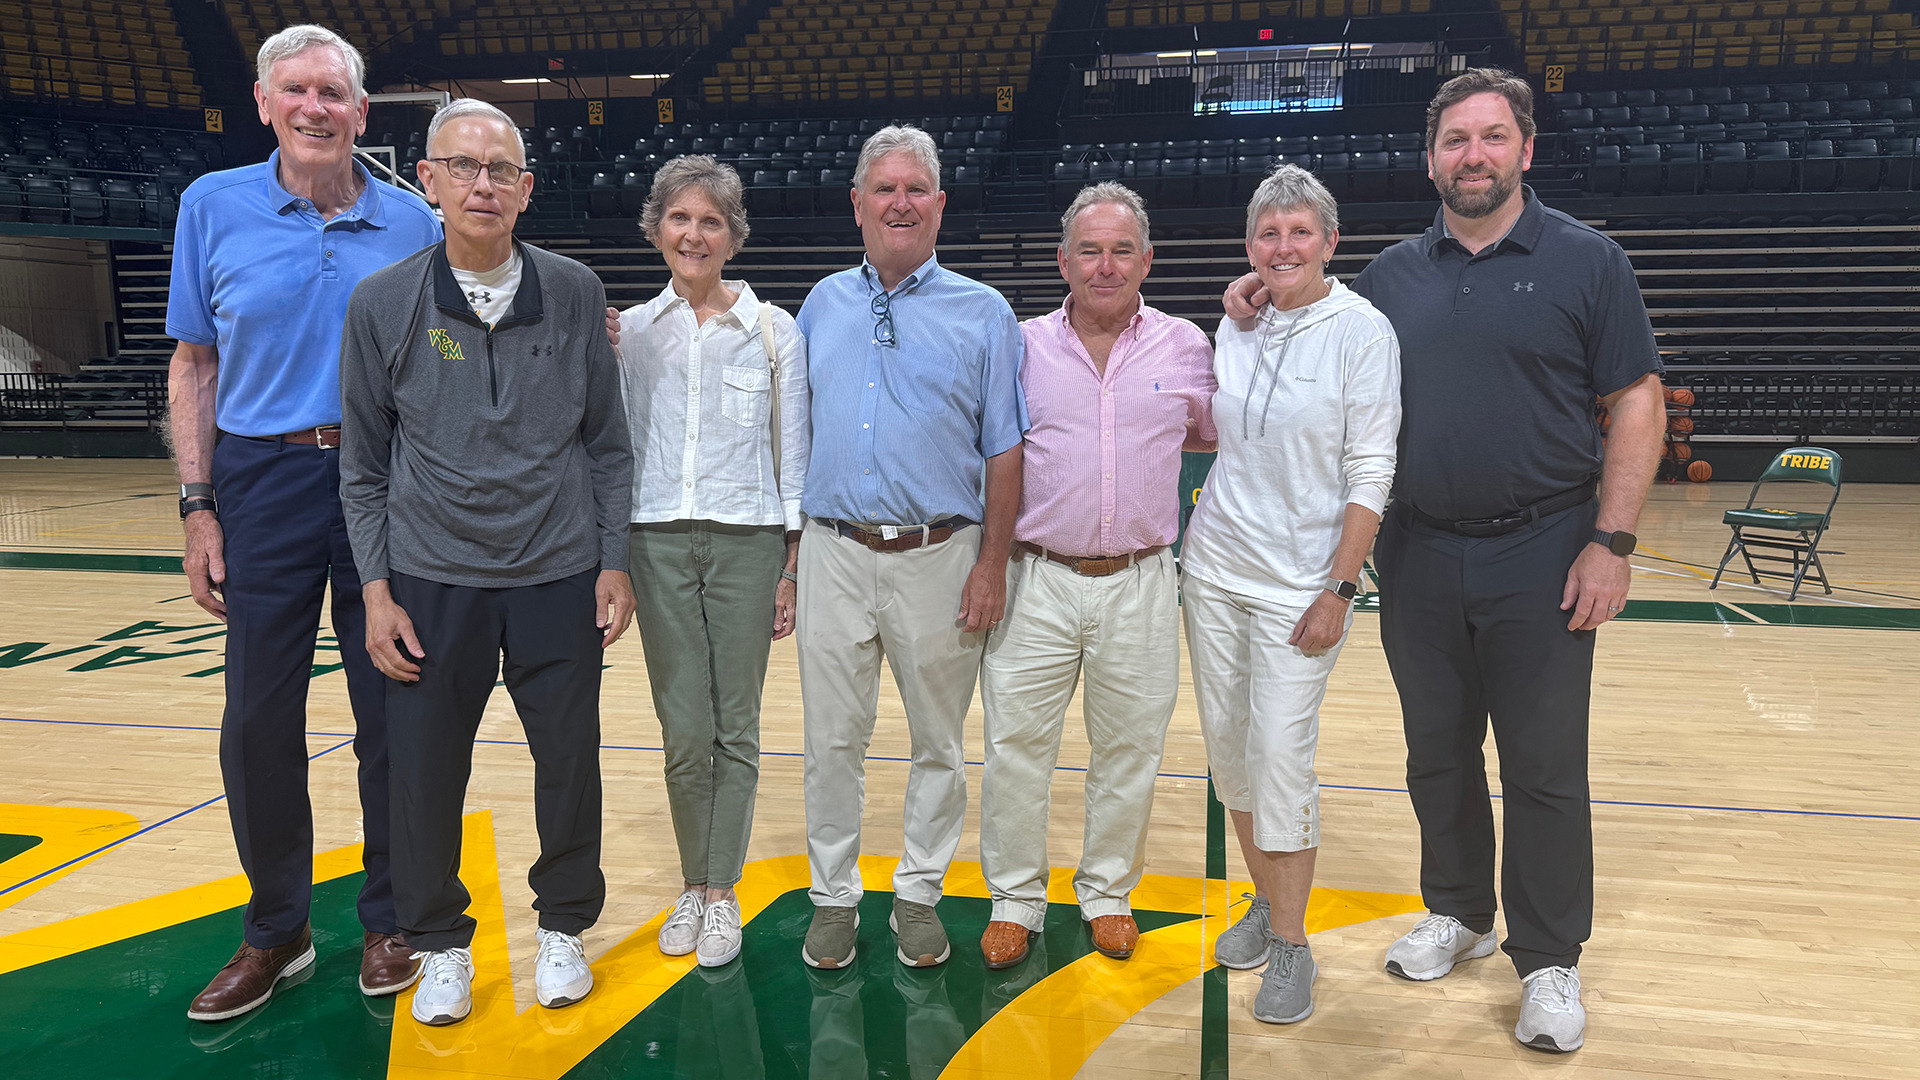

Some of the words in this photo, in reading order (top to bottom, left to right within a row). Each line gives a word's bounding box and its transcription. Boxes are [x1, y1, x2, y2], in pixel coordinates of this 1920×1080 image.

[1547, 67, 1563, 80] 22
[998, 88, 1011, 100] 24
[589, 103, 602, 114] 25
[659, 101, 672, 112] 24
[206, 110, 220, 121] 27
[1780, 454, 1833, 470] TRIBE
